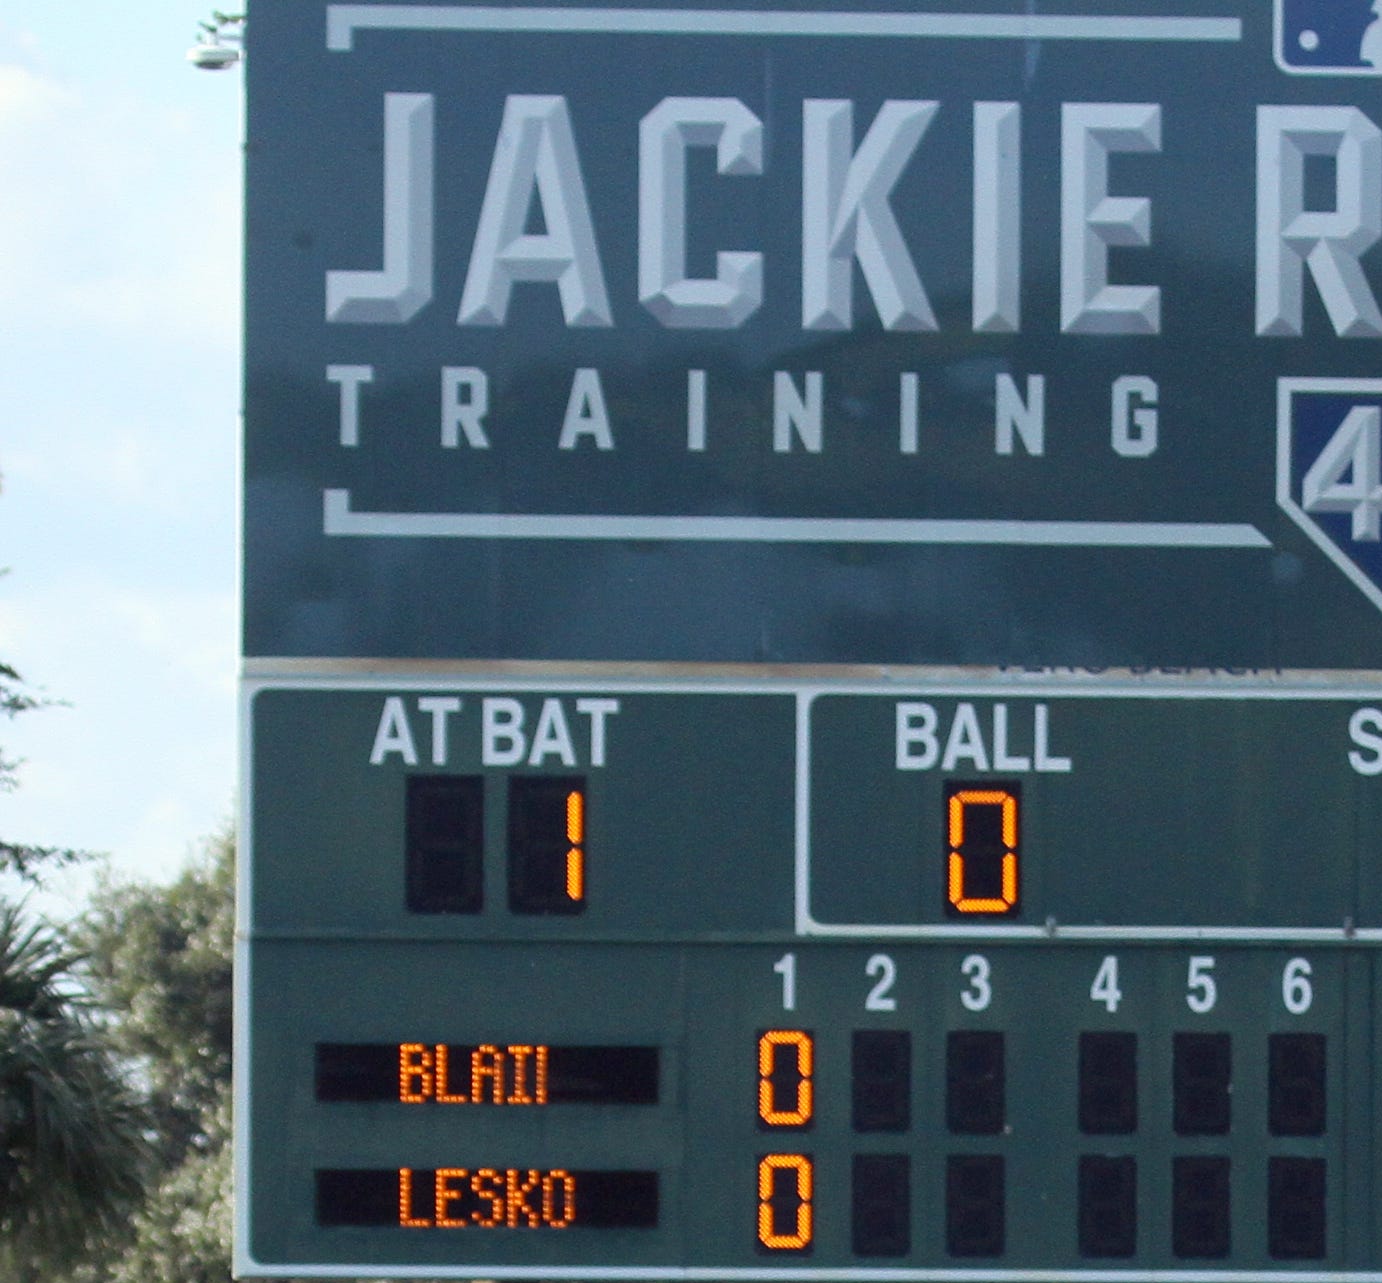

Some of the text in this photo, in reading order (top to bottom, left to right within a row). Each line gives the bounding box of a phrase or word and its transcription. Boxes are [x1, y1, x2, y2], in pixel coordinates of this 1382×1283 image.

[325, 92, 1164, 336] JACKIE
[325, 364, 1161, 457] TRAINING
[370, 697, 619, 767] AT BAT
[894, 703, 1073, 772] BALL
[566, 790, 584, 902] 1
[948, 790, 1017, 913] 0
[773, 956, 797, 1010] 1
[865, 954, 896, 1011] 2
[961, 955, 993, 1012] 3
[1090, 955, 1122, 1013] 4
[1186, 956, 1217, 1013] 5
[1282, 957, 1313, 1014] 6
[758, 1030, 814, 1126] 0
[398, 1169, 577, 1229] LESKO
[758, 1154, 814, 1250] 0
